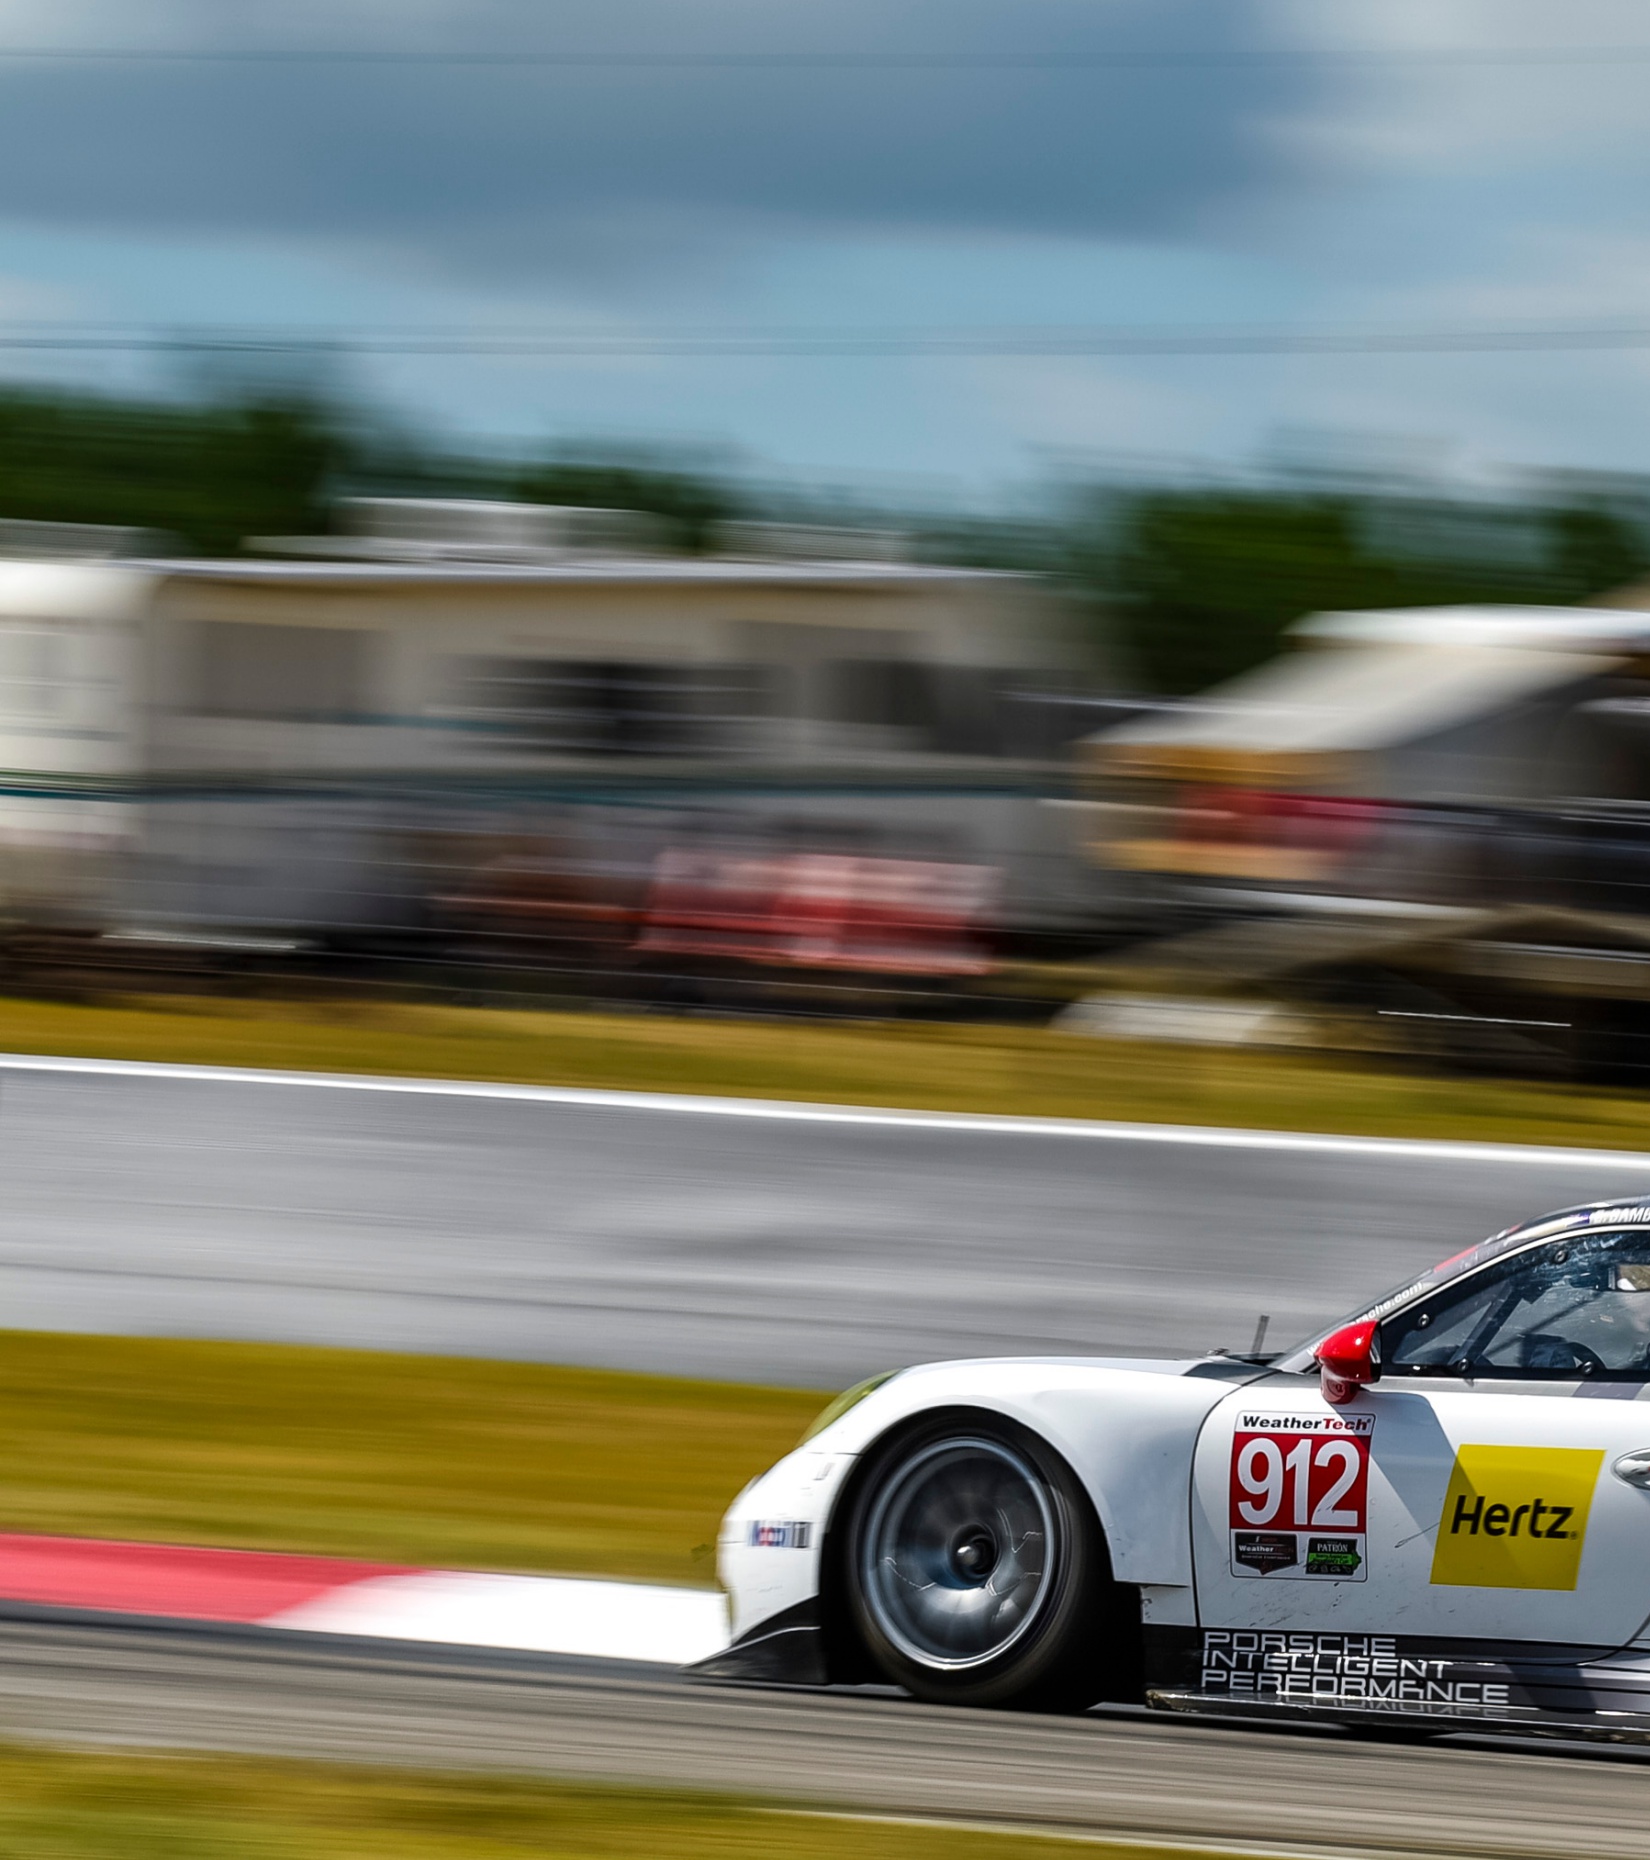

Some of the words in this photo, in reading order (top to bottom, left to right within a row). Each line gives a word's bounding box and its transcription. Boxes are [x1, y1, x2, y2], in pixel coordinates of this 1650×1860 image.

[1243, 1415, 1370, 1431] WeatherTech
[1237, 1437, 1360, 1527] 912
[1450, 1494, 1575, 1539] Hertz
[1203, 1631, 1397, 1658] PORSCHE
[1202, 1650, 1454, 1679] INTELLIGENT
[1201, 1669, 1510, 1704] PERFORMANCE
